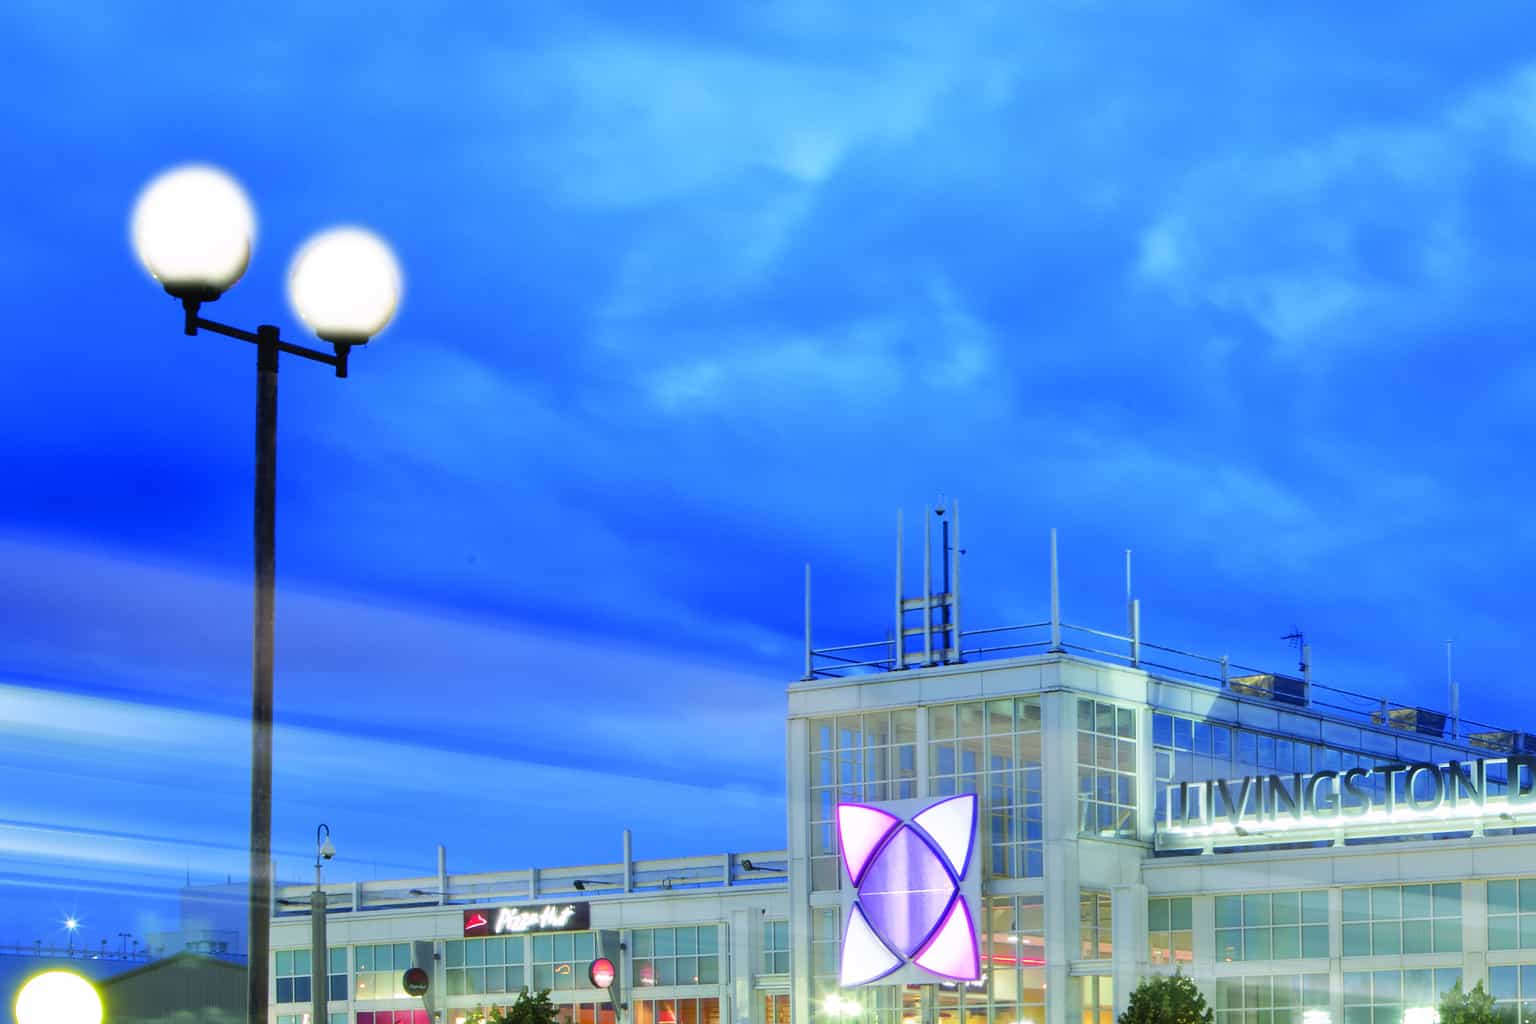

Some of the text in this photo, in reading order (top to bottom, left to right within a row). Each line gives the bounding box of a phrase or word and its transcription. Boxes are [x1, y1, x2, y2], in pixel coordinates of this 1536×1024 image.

[1180, 759, 1487, 828] LIVINGSTON
[495, 904, 575, 934] Pizza Hut
